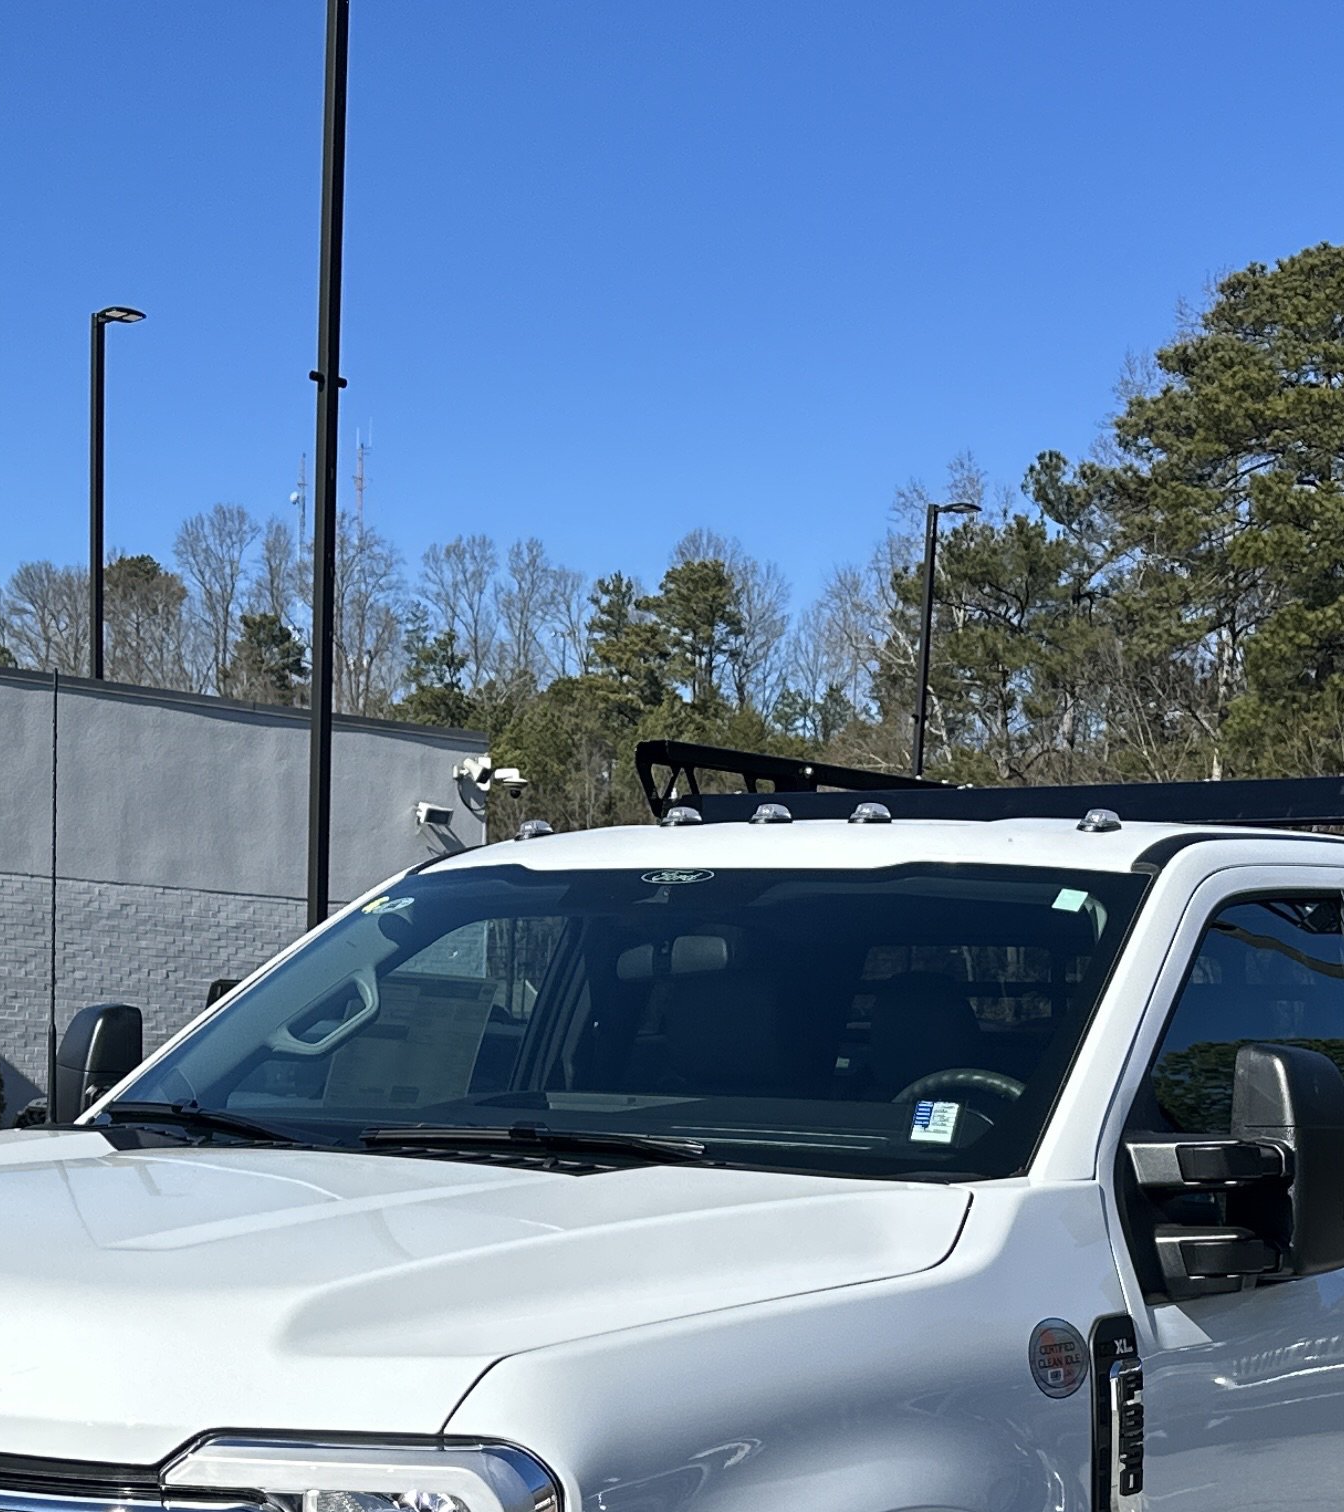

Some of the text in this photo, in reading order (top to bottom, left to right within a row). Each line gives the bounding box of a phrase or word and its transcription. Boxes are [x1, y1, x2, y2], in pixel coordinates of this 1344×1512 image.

[1114, 1338, 1134, 1355] XL
[1038, 1354, 1081, 1369] CLEAN IDLE
